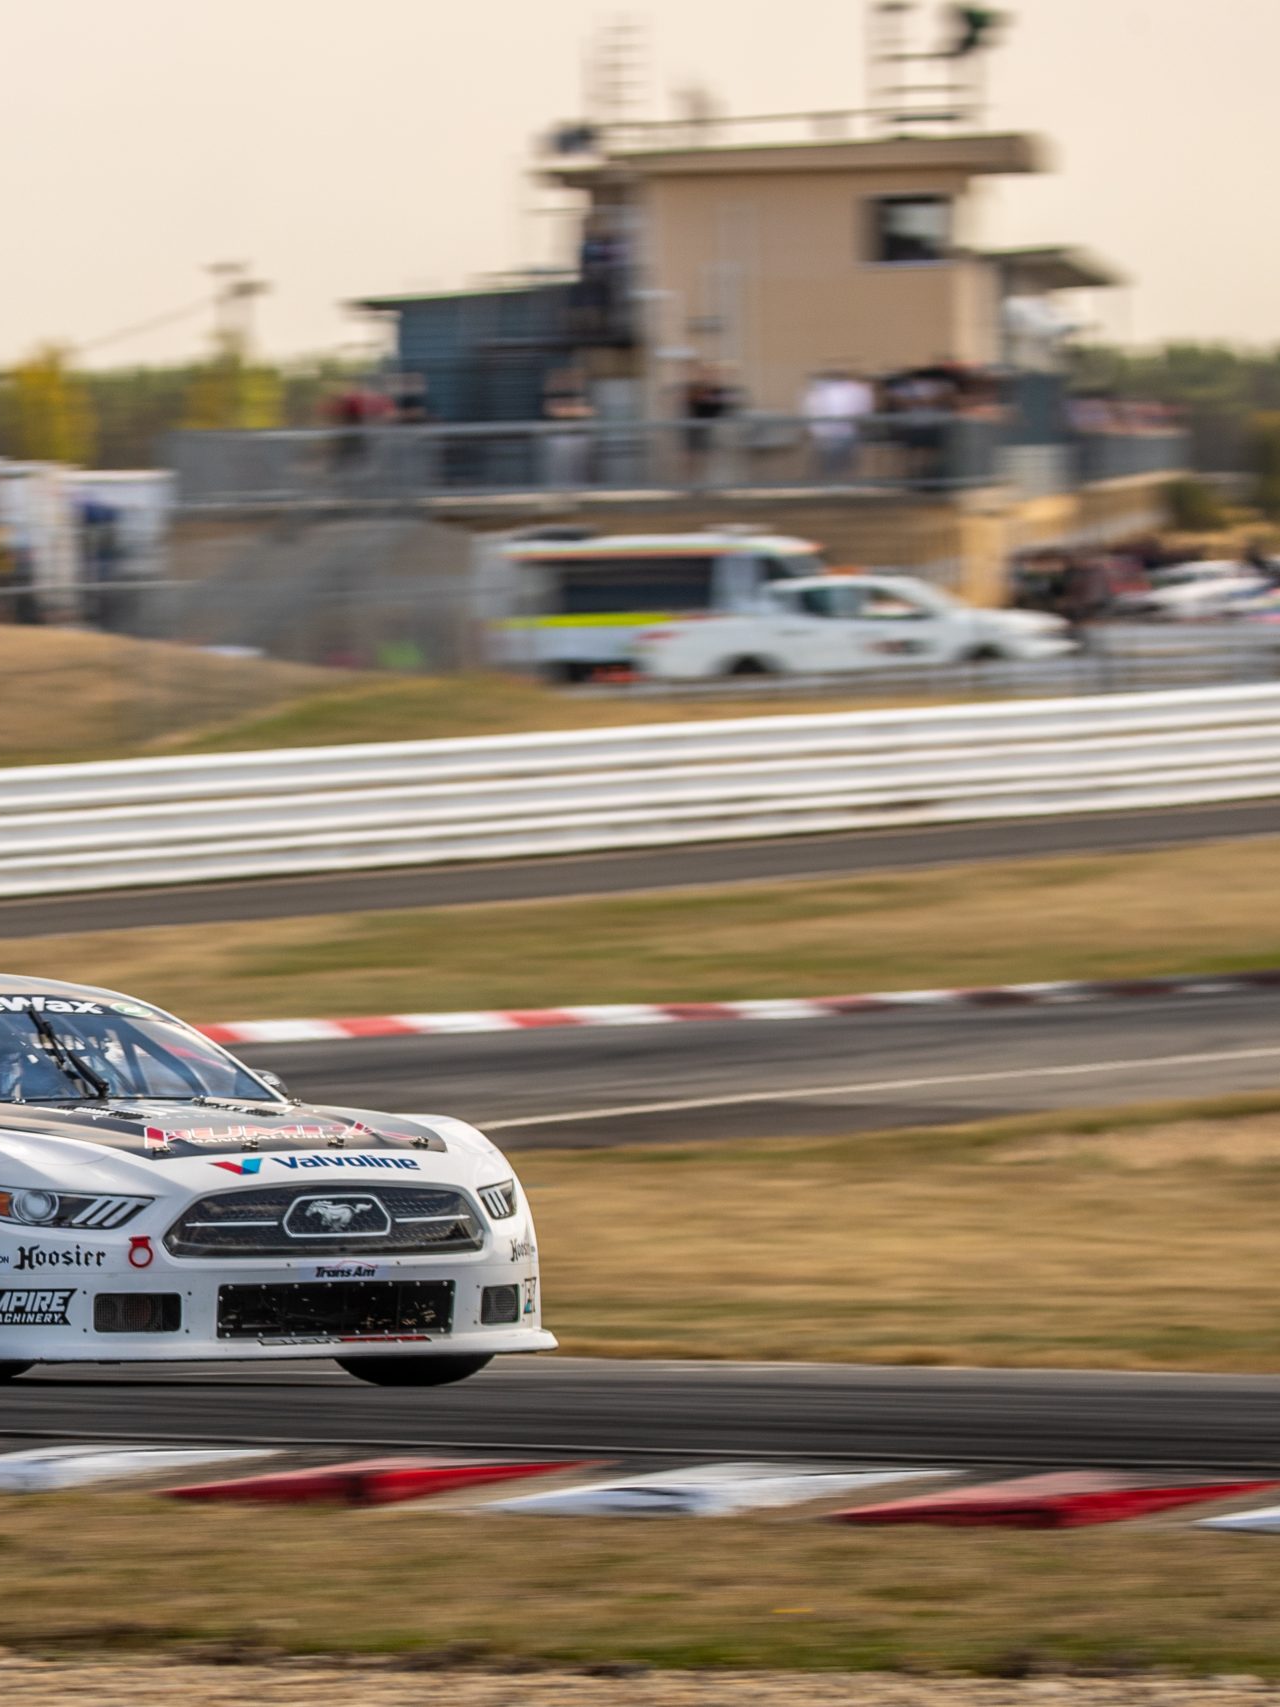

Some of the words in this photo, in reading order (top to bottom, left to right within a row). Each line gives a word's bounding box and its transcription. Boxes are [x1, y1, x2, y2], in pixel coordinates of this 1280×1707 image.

[271, 1154, 422, 1171] Valvoline
[13, 1244, 107, 1270] Hoosier
[315, 1266, 351, 1278] Trans
[352, 1265, 376, 1277] Am
